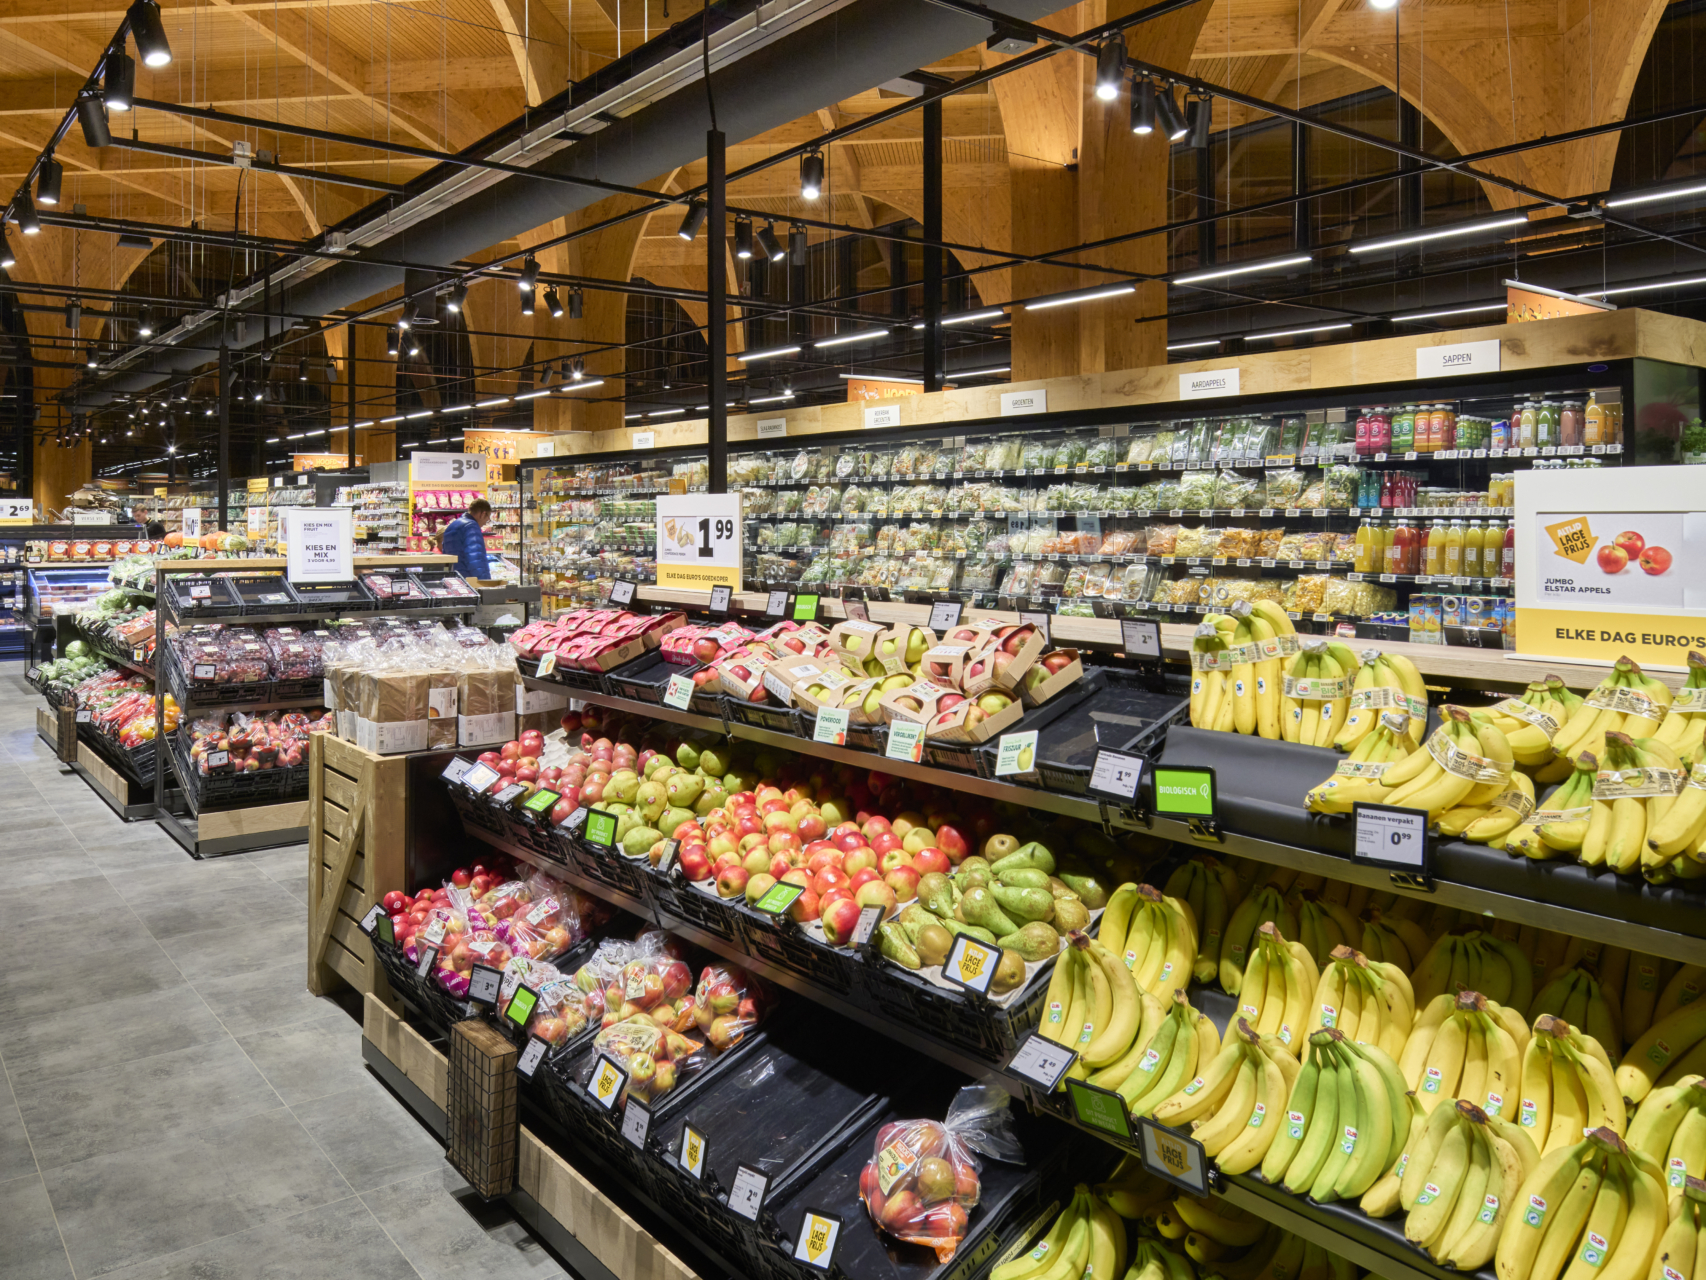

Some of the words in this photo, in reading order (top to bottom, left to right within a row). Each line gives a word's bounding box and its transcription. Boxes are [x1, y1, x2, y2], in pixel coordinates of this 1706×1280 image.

[1442, 353, 1472, 364] SAPPEN
[1191, 378, 1226, 389] AARDAPPELS
[1012, 398, 1034, 406] GROENTEN
[1557, 522, 1582, 537] ALTIJD
[1559, 529, 1586, 547] LAGE
[1563, 540, 1590, 556] PRIJS
[1556, 628, 1596, 641] ELKE
[1600, 630, 1637, 644] DAG
[1320, 687, 1337, 695] BIO
[1159, 785, 1197, 796] BIOLOGISCH
[1357, 812, 1386, 822] Bananen
[1387, 816, 1414, 825] verpakt
[965, 954, 981, 967] LAGE
[961, 963, 978, 976] PRIJS
[1324, 1005, 1335, 1014] Dole
[1428, 1068, 1440, 1076] Dole
[1489, 1093, 1502, 1103] Dole
[1523, 1100, 1534, 1109] Dole
[1291, 1113, 1302, 1122] Dole
[1346, 1129, 1358, 1138] Dole
[689, 1142, 699, 1155] LAGE
[1161, 1137, 1182, 1152] ALTIJD
[688, 1150, 698, 1163] PRIJS
[1161, 1144, 1183, 1161] LAGE
[1162, 1153, 1184, 1170] PRIJS
[1671, 1159, 1683, 1168] Dole
[1426, 1184, 1438, 1193] Dole
[1486, 1196, 1497, 1205] Dole
[1531, 1196, 1546, 1208] Dole
[811, 1230, 825, 1242] LAGE
[1590, 1234, 1606, 1247] Dole
[809, 1239, 823, 1252] PRIJS
